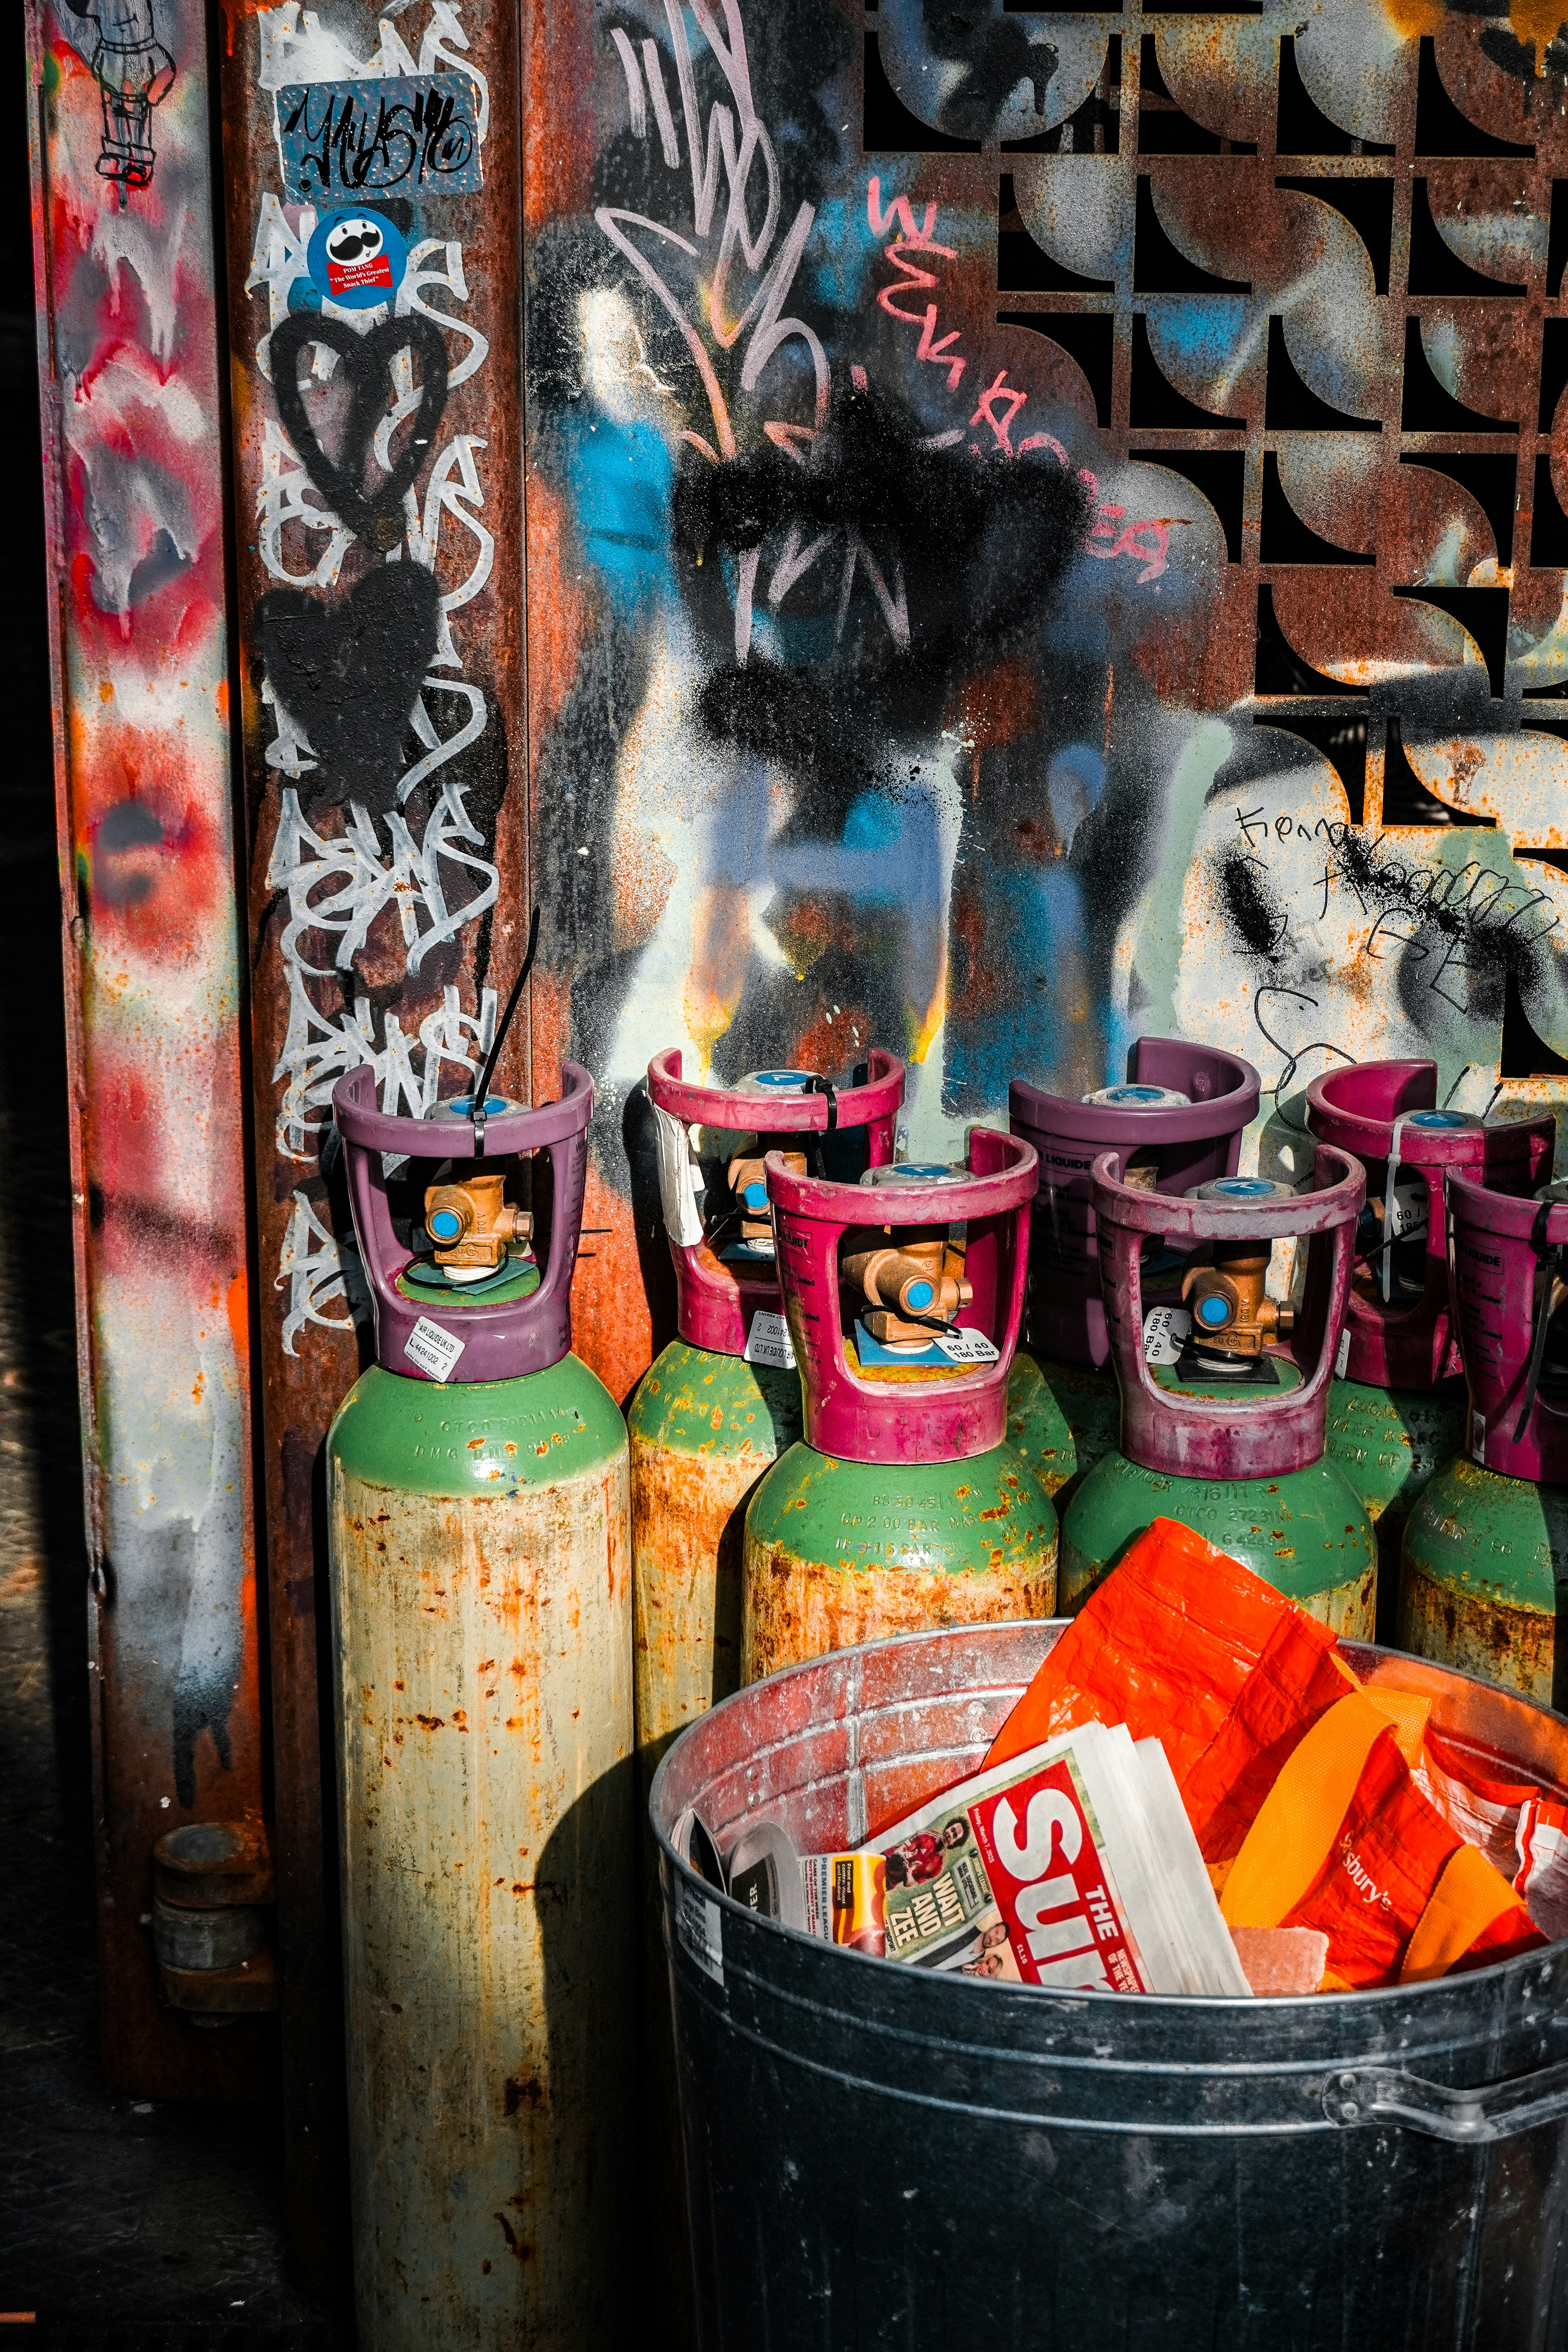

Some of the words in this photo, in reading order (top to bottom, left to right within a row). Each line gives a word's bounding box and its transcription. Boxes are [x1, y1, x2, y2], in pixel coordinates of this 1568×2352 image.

[345, 271, 366, 281] World's
[366, 267, 389, 277] Greatest
[357, 263, 373, 271] TANG
[1046, 1153, 1091, 1170] LIQUIDE
[1397, 1209, 1411, 1221] 60
[757, 1323, 762, 1331] 2
[1150, 1311, 1162, 1332] 180
[1162, 1312, 1172, 1327] 60
[767, 1325, 790, 1337] 241002
[426, 1328, 442, 1344] LIQUIDE
[440, 1338, 448, 1348] UK
[446, 1342, 455, 1353] LTD
[754, 1343, 763, 1353] LTD
[409, 1338, 414, 1347] L
[415, 1344, 439, 1364] 44241002
[763, 1345, 770, 1355] UK
[769, 1346, 787, 1358] LIQUIDE
[1152, 1341, 1162, 1357] 40
[872, 1494, 891, 1507] BS
[907, 1517, 941, 1532] BAR
[901, 1542, 932, 1556] BAR
[979, 1826, 987, 1844] March
[987, 1849, 995, 1864] 2025
[814, 1877, 817, 1887] OF
[933, 1871, 966, 1927] WAIT
[911, 1892, 942, 1937] AND
[1085, 1885, 1119, 1941] THE
[890, 1906, 919, 1948] ZEE
[1016, 1943, 1028, 1965] £1.10
[1108, 1952, 1119, 1964] OF
[1112, 1963, 1124, 1981] THE
